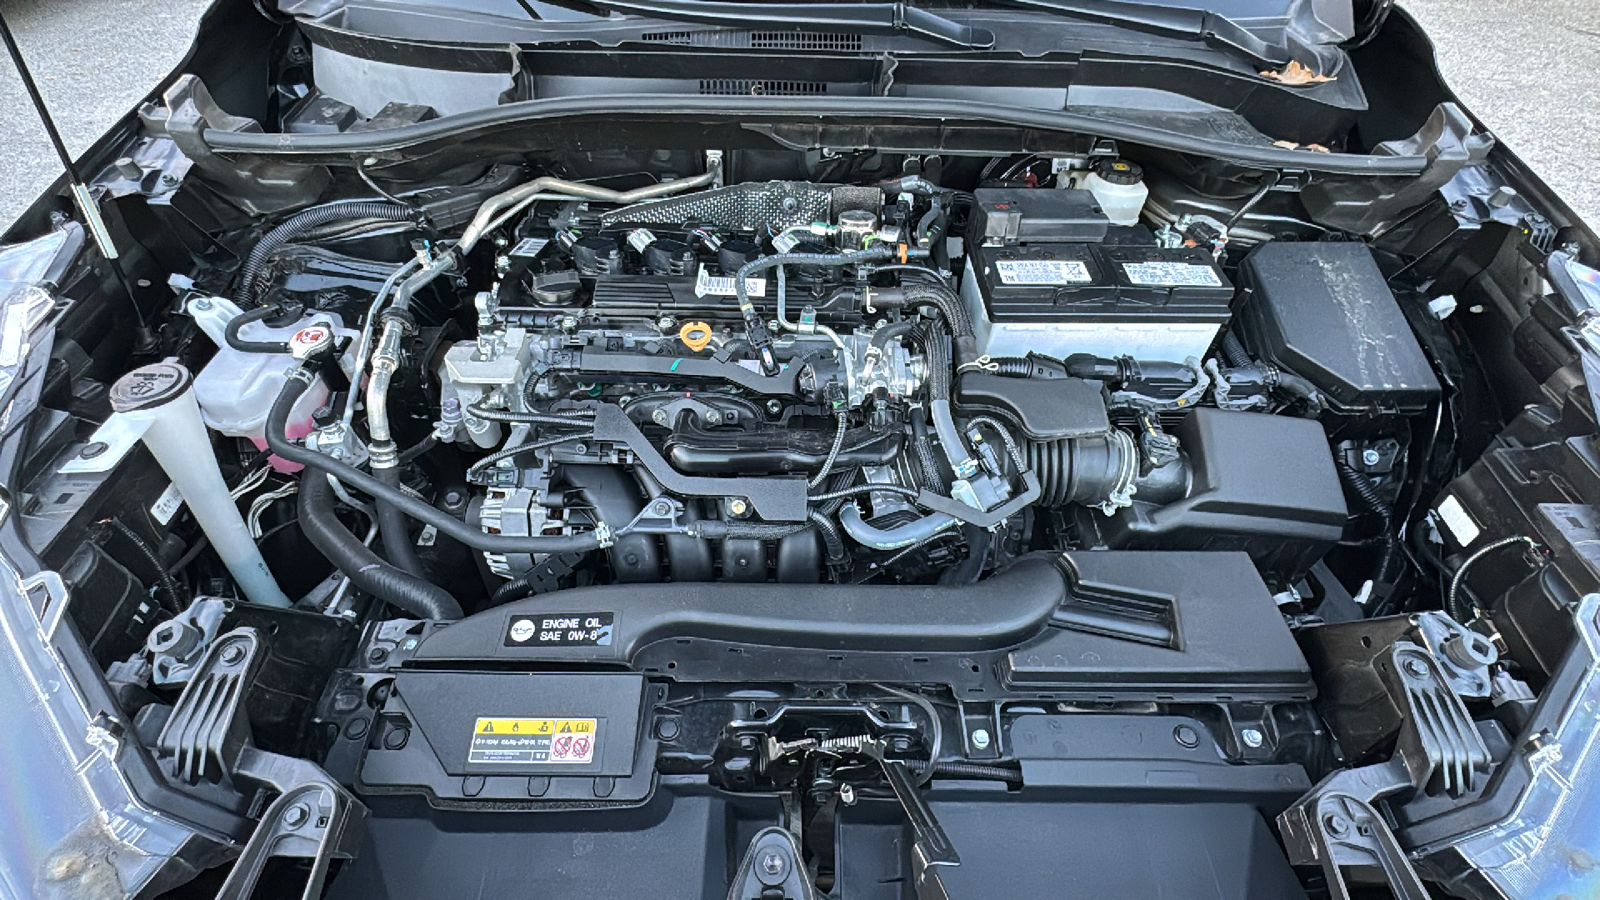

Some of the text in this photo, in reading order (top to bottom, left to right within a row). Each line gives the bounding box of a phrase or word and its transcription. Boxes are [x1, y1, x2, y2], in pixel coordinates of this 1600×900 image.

[542, 617, 602, 629] ENGINE OIL
[540, 630, 598, 641] SAE 0W-8
